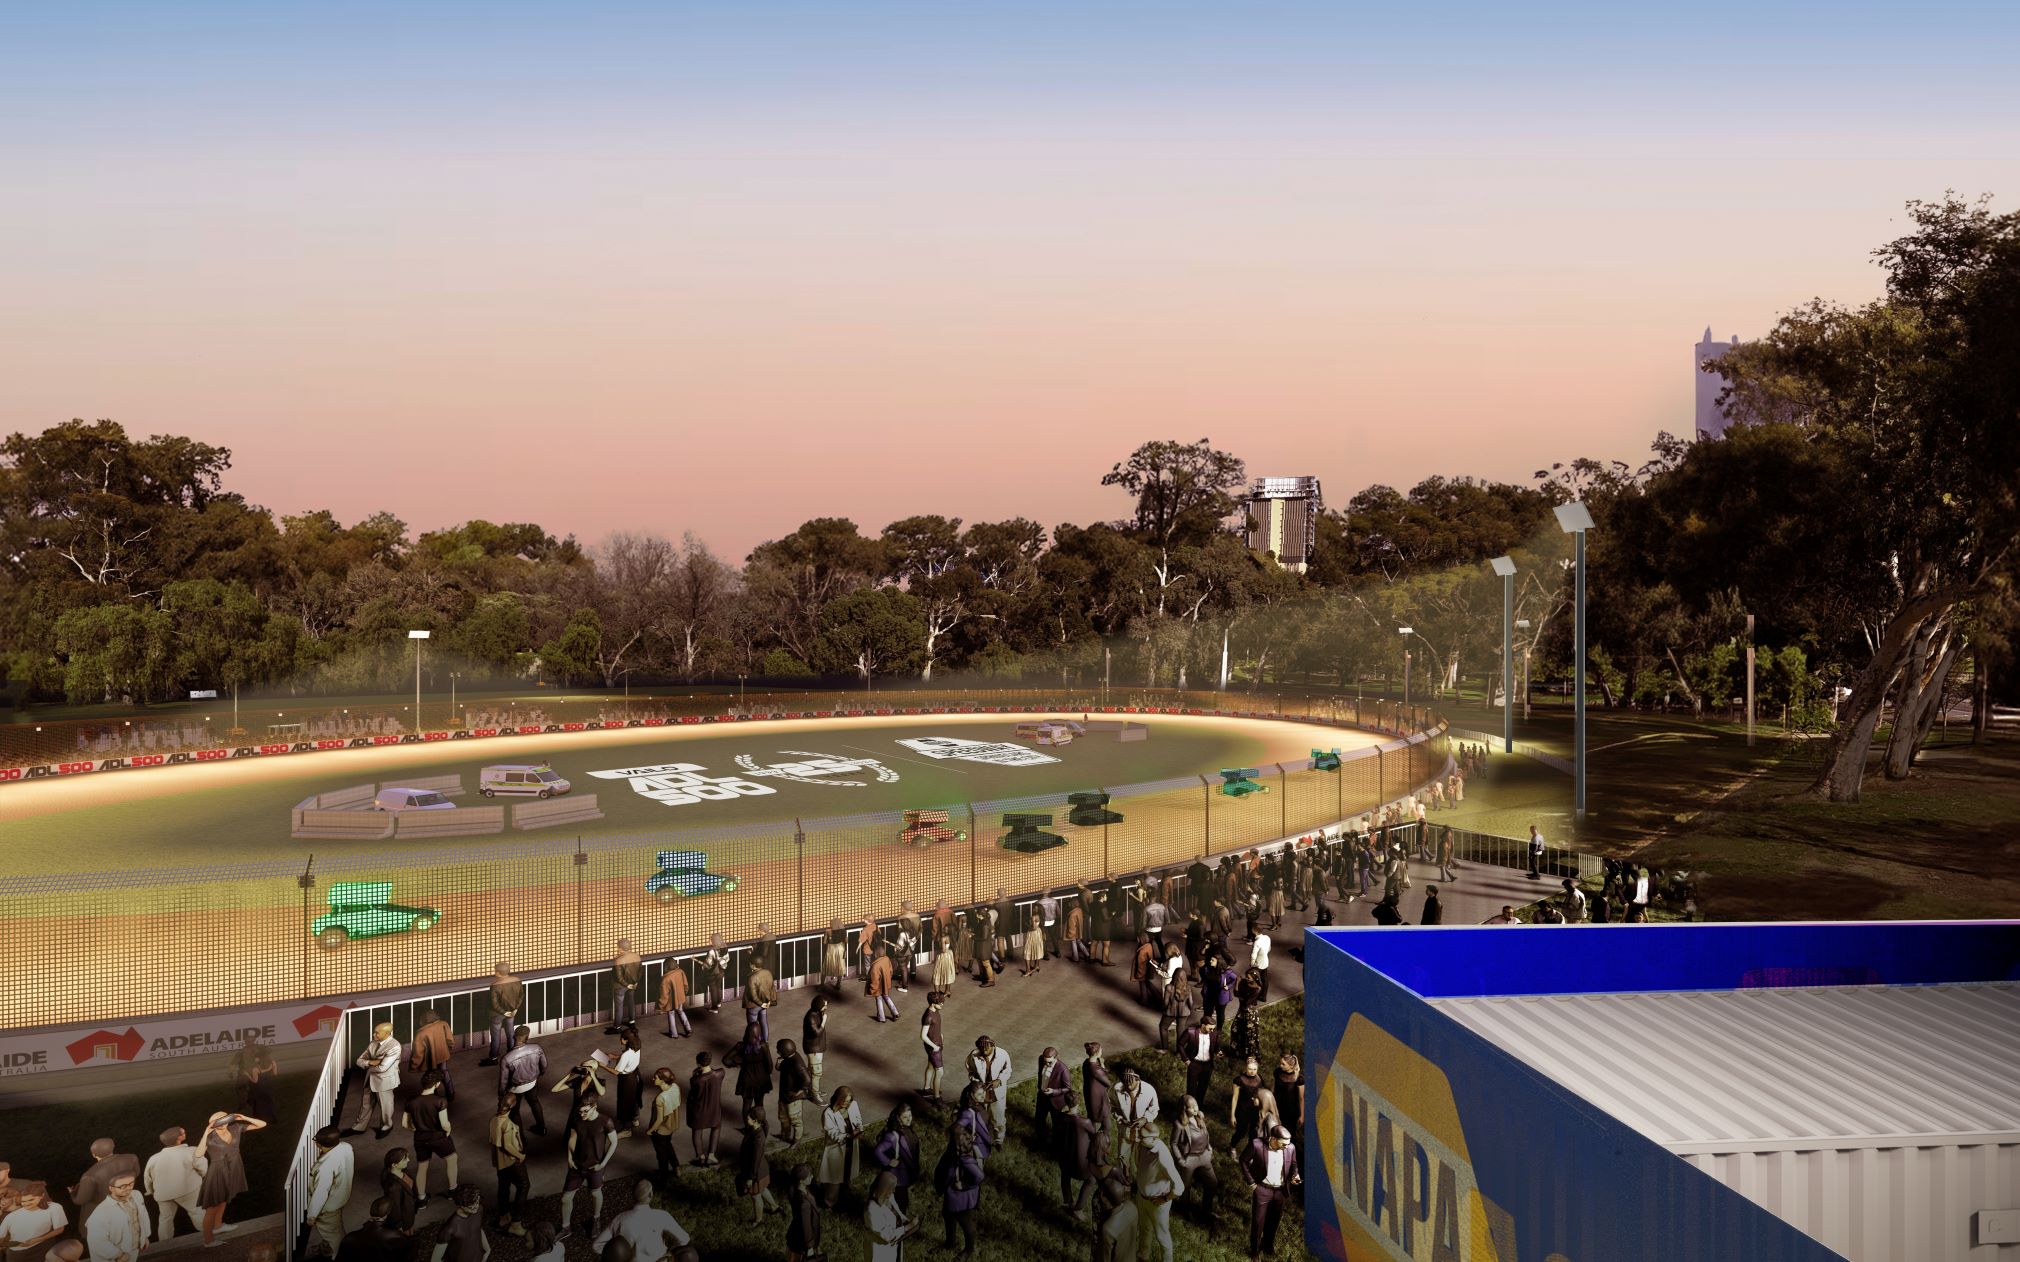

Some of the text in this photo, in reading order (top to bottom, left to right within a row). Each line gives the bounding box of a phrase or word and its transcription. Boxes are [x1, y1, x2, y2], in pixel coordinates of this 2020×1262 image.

[24, 761, 94, 778] ADL500
[99, 754, 164, 770] ADL500
[167, 749, 227, 763] ADL500
[232, 744, 289, 757] ADL500
[291, 739, 345, 752] ADL500
[349, 735, 399, 747] ADL500
[401, 732, 448, 743] ADL500
[452, 729, 497, 739] ADL500
[498, 725, 541, 736] ADL500
[544, 723, 584, 733] ADL500
[628, 771, 744, 793] ADL
[637, 781, 777, 806] 500
[149, 1038, 276, 1060] SOUTH AUSTRLIA
[150, 1024, 276, 1051] ADELAIDE
[0, 1050, 48, 1068] IDE
[1342, 1082, 1461, 1262] NAPA
